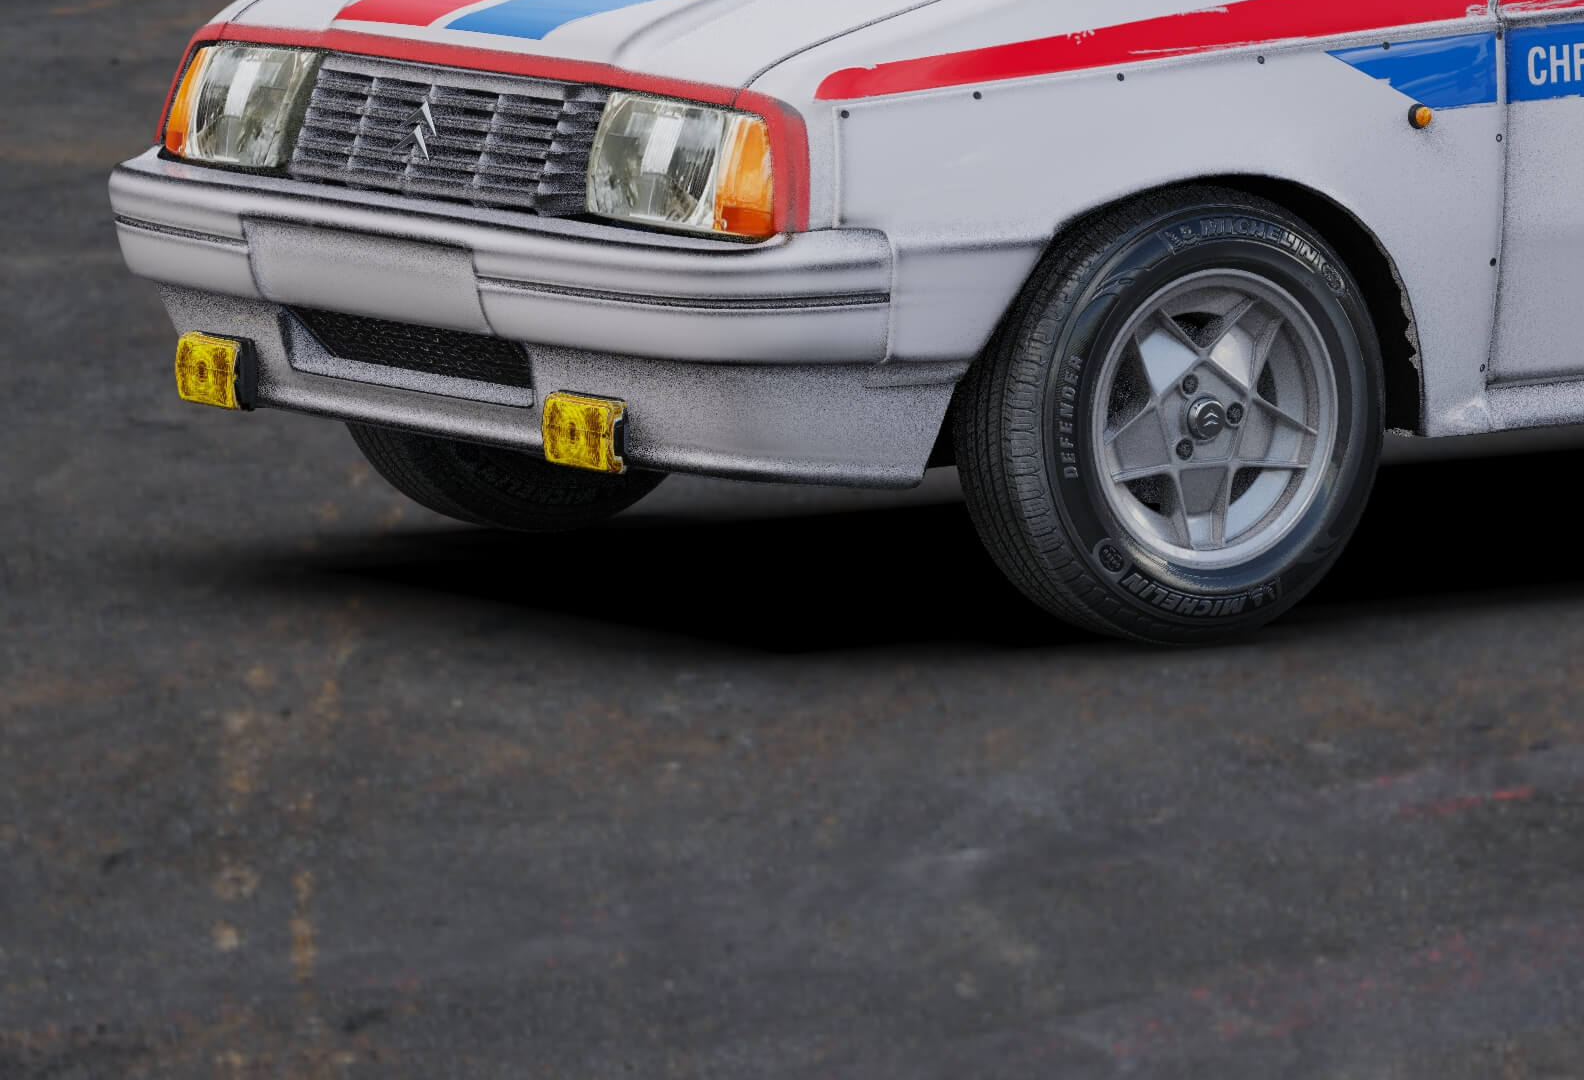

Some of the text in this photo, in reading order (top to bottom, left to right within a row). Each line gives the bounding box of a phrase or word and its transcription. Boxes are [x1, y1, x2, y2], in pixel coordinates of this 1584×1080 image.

[1200, 216, 1322, 266] MICHELIN
[1058, 354, 1083, 480] DEFENDER
[1121, 572, 1247, 617] MICHELIN
